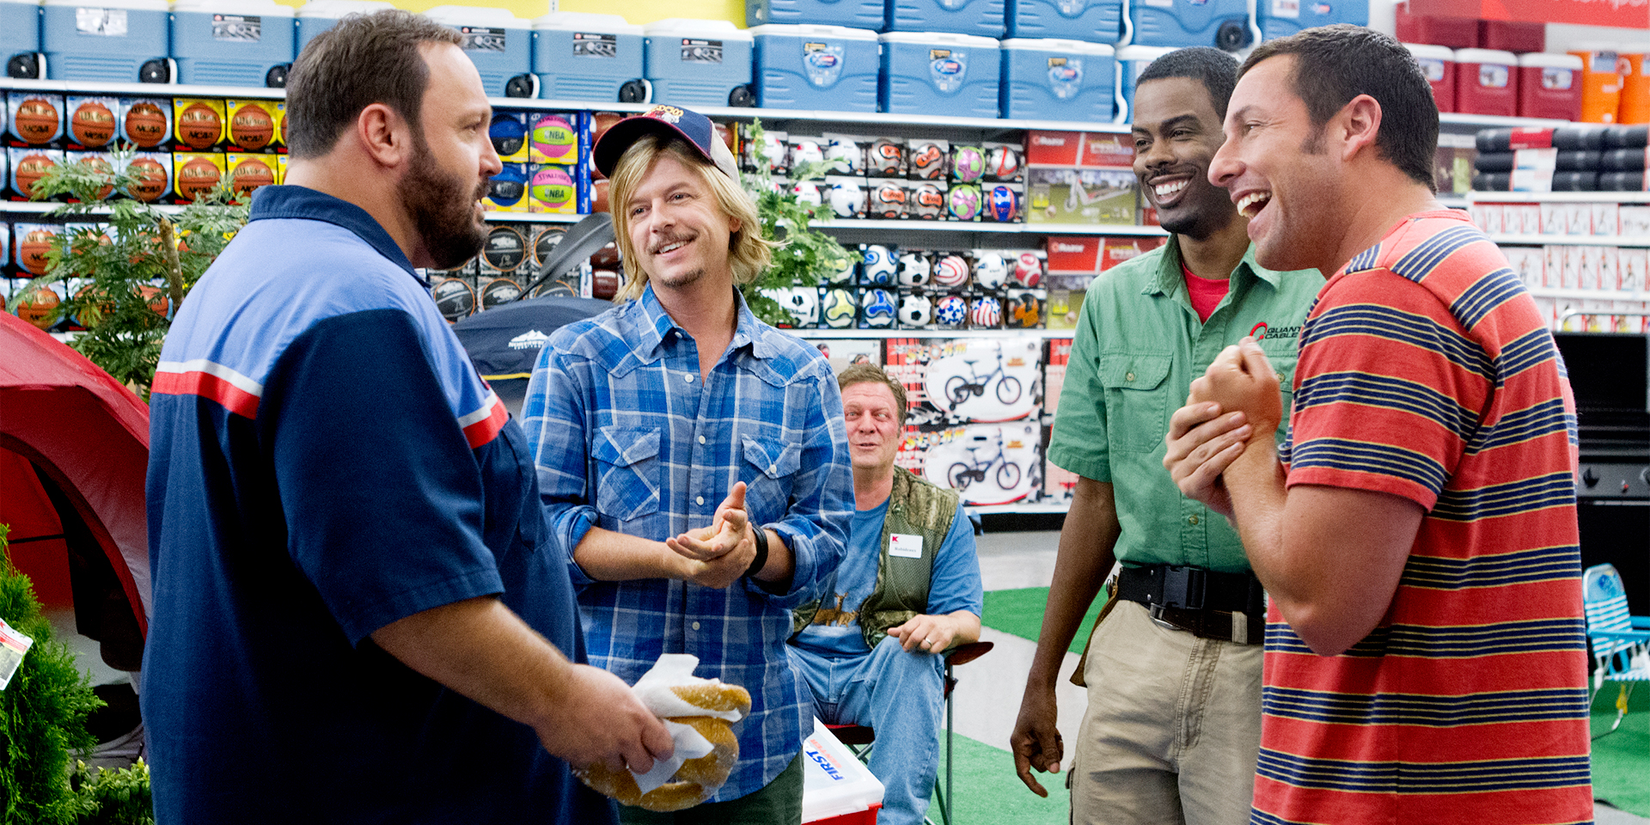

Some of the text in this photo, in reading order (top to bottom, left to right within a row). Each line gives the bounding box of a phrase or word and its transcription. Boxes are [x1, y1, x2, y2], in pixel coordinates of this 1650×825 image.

[235, 115, 268, 127] Wilson
[549, 130, 566, 141] NBA
[183, 165, 217, 178] Wilson
[234, 165, 269, 177] Wilson
[549, 189, 565, 199] NBA
[1264, 332, 1299, 340] CABLE
[805, 750, 844, 781] FIRST
